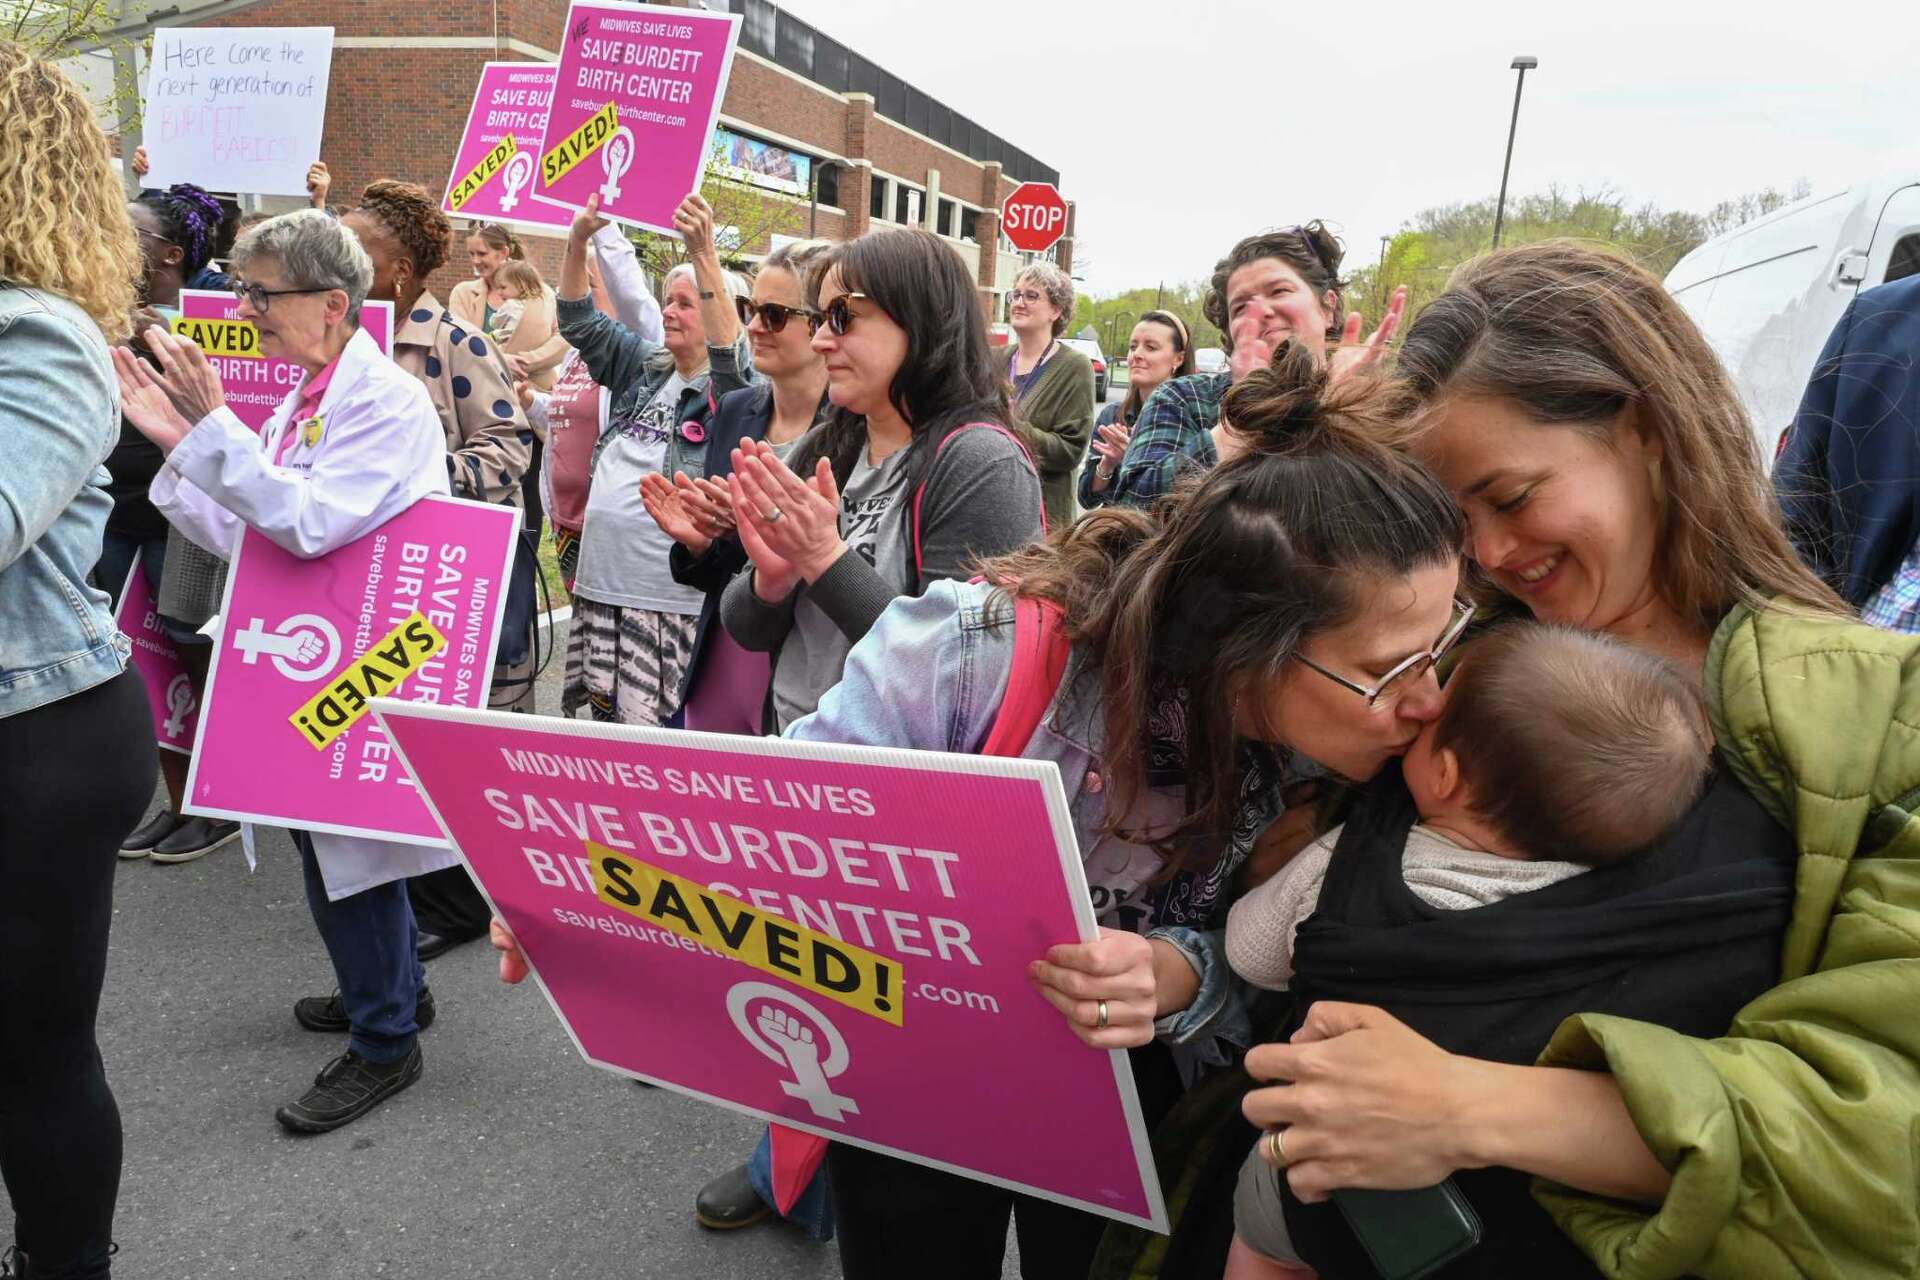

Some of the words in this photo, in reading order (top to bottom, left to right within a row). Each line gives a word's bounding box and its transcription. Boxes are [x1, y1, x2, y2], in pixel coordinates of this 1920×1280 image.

[600, 17, 642, 34] MIDWIVES
[643, 22, 666, 37] SAVE
[667, 25, 693, 39] LIVES
[164, 38, 216, 72] Here
[280, 42, 304, 64] the
[581, 38, 622, 63] SAVE
[624, 43, 703, 73] BURDETT
[157, 73, 199, 96] next
[205, 71, 293, 102] generation
[296, 75, 315, 97] of
[491, 89, 526, 106] SAVE
[577, 67, 625, 93] BIRTH
[627, 75, 693, 104] CENTER
[486, 111, 527, 128] BIRTH
[545, 106, 615, 180] SAVED!
[453, 137, 514, 207] SAVED!
[1006, 203, 1063, 232] STOP
[428, 543, 467, 630] SAVE
[459, 577, 489, 665] MIDWIVES
[299, 620, 435, 743] SAVED!
[451, 668, 473, 706] SAV
[500, 747, 660, 791] MIDWIVES
[663, 768, 761, 804] SAVE
[763, 778, 876, 817] LIVES
[483, 788, 636, 850] SAVE
[638, 811, 960, 899] BURDETT
[521, 846, 598, 895] BIR
[601, 856, 892, 1013] SAVED!
